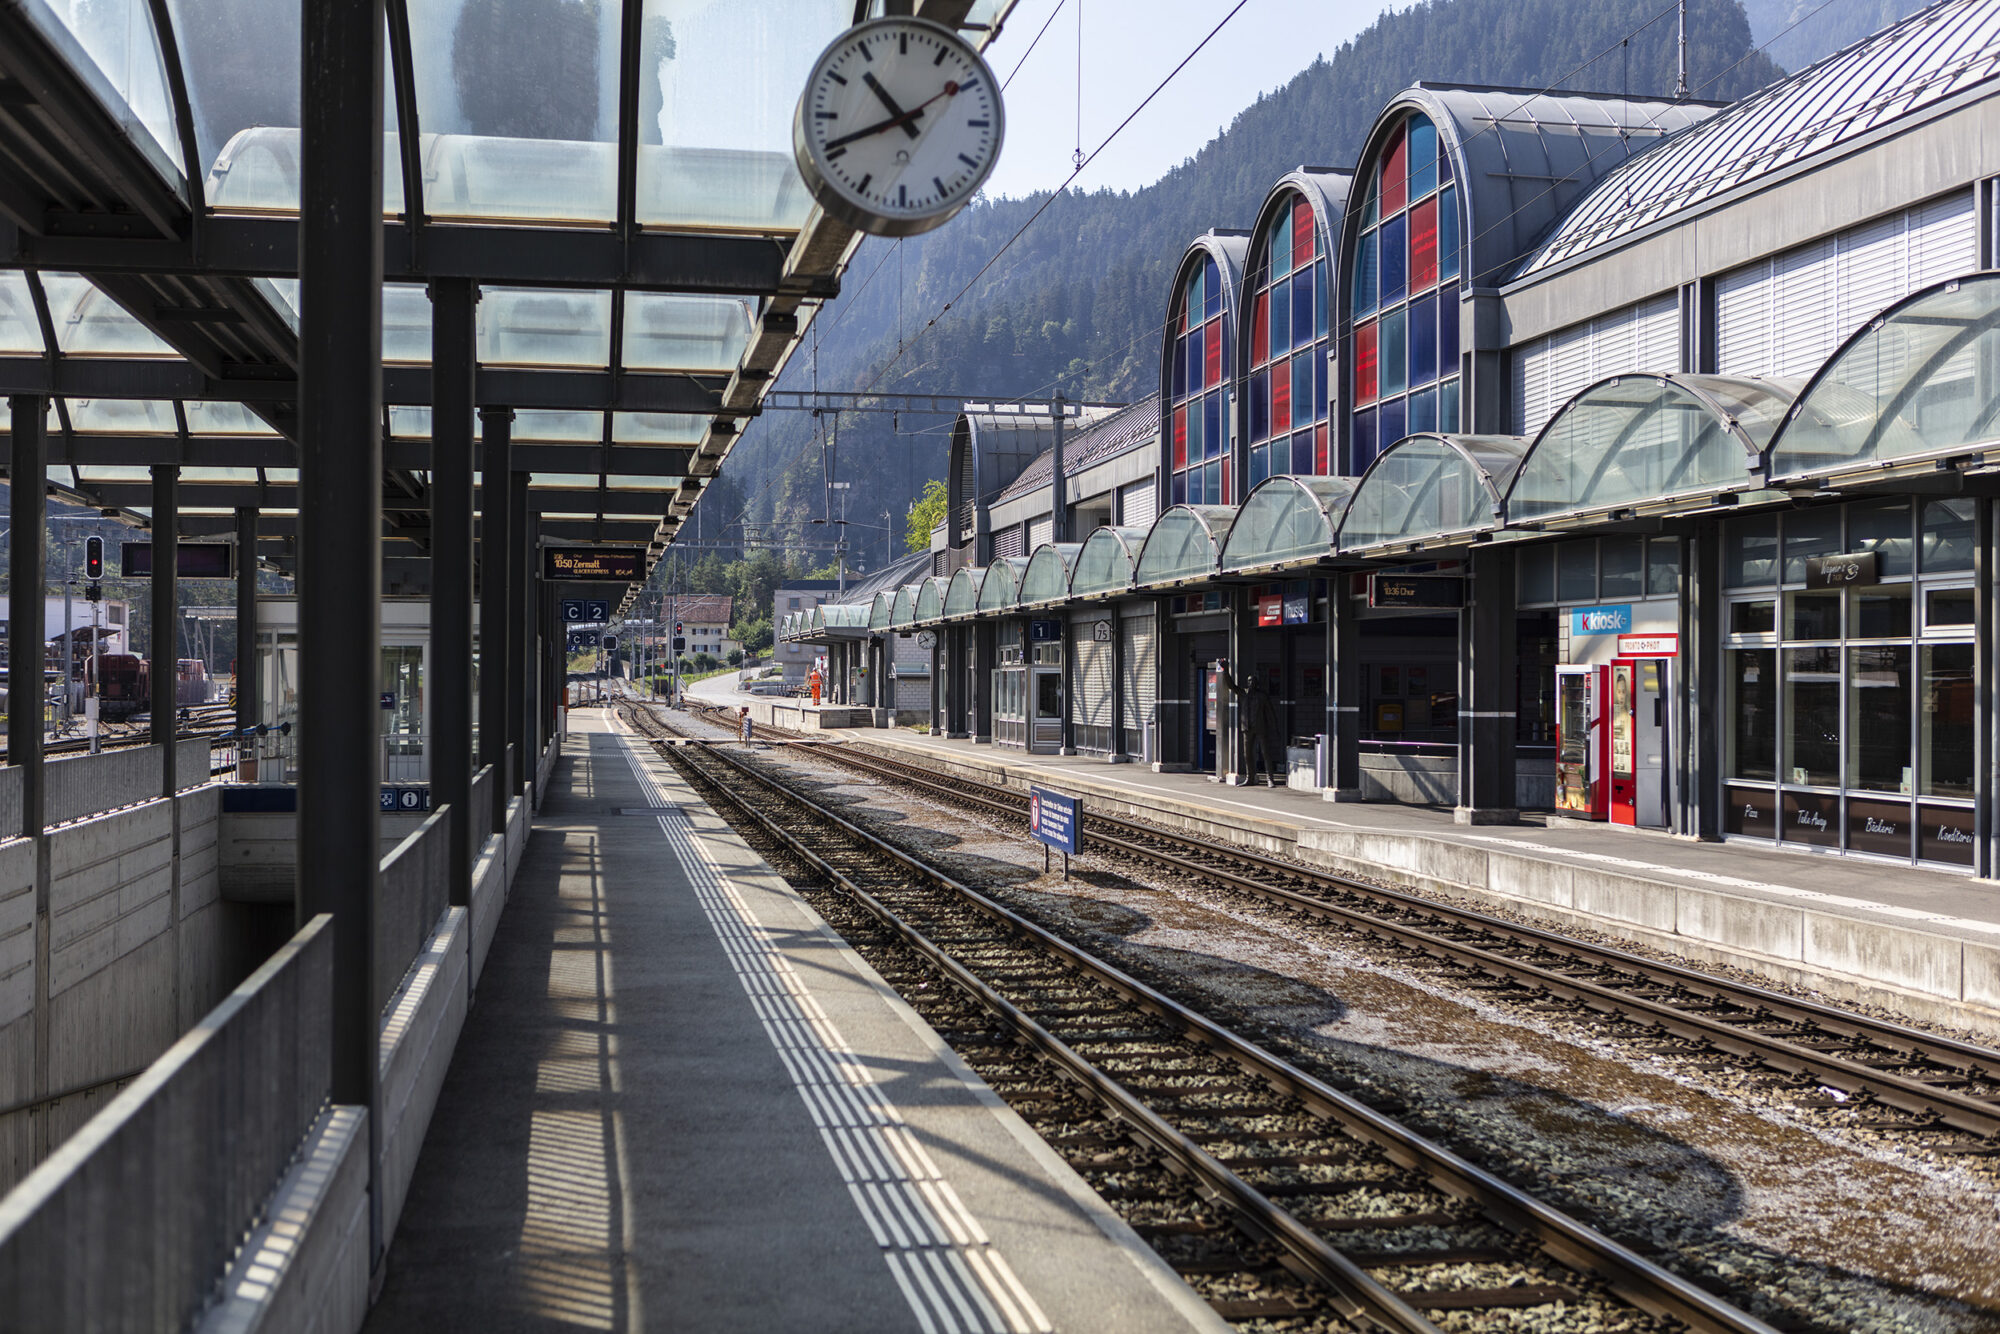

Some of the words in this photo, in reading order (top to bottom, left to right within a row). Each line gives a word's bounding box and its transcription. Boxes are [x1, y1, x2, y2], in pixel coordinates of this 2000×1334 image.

[554, 559, 572, 568] 10:50
[573, 559, 600, 569] Zermatt
[1400, 587, 1416, 596] Chur
[568, 606, 578, 619] C
[593, 607, 602, 619] 2
[1285, 603, 1304, 619] Thusis
[1038, 627, 1043, 637] 1
[1097, 629, 1108, 640] 75
[573, 635, 580, 644] C
[589, 635, 596, 644] 2
[1865, 817, 1896, 835] Bäckerei
[1937, 824, 1975, 844] Konditorei
